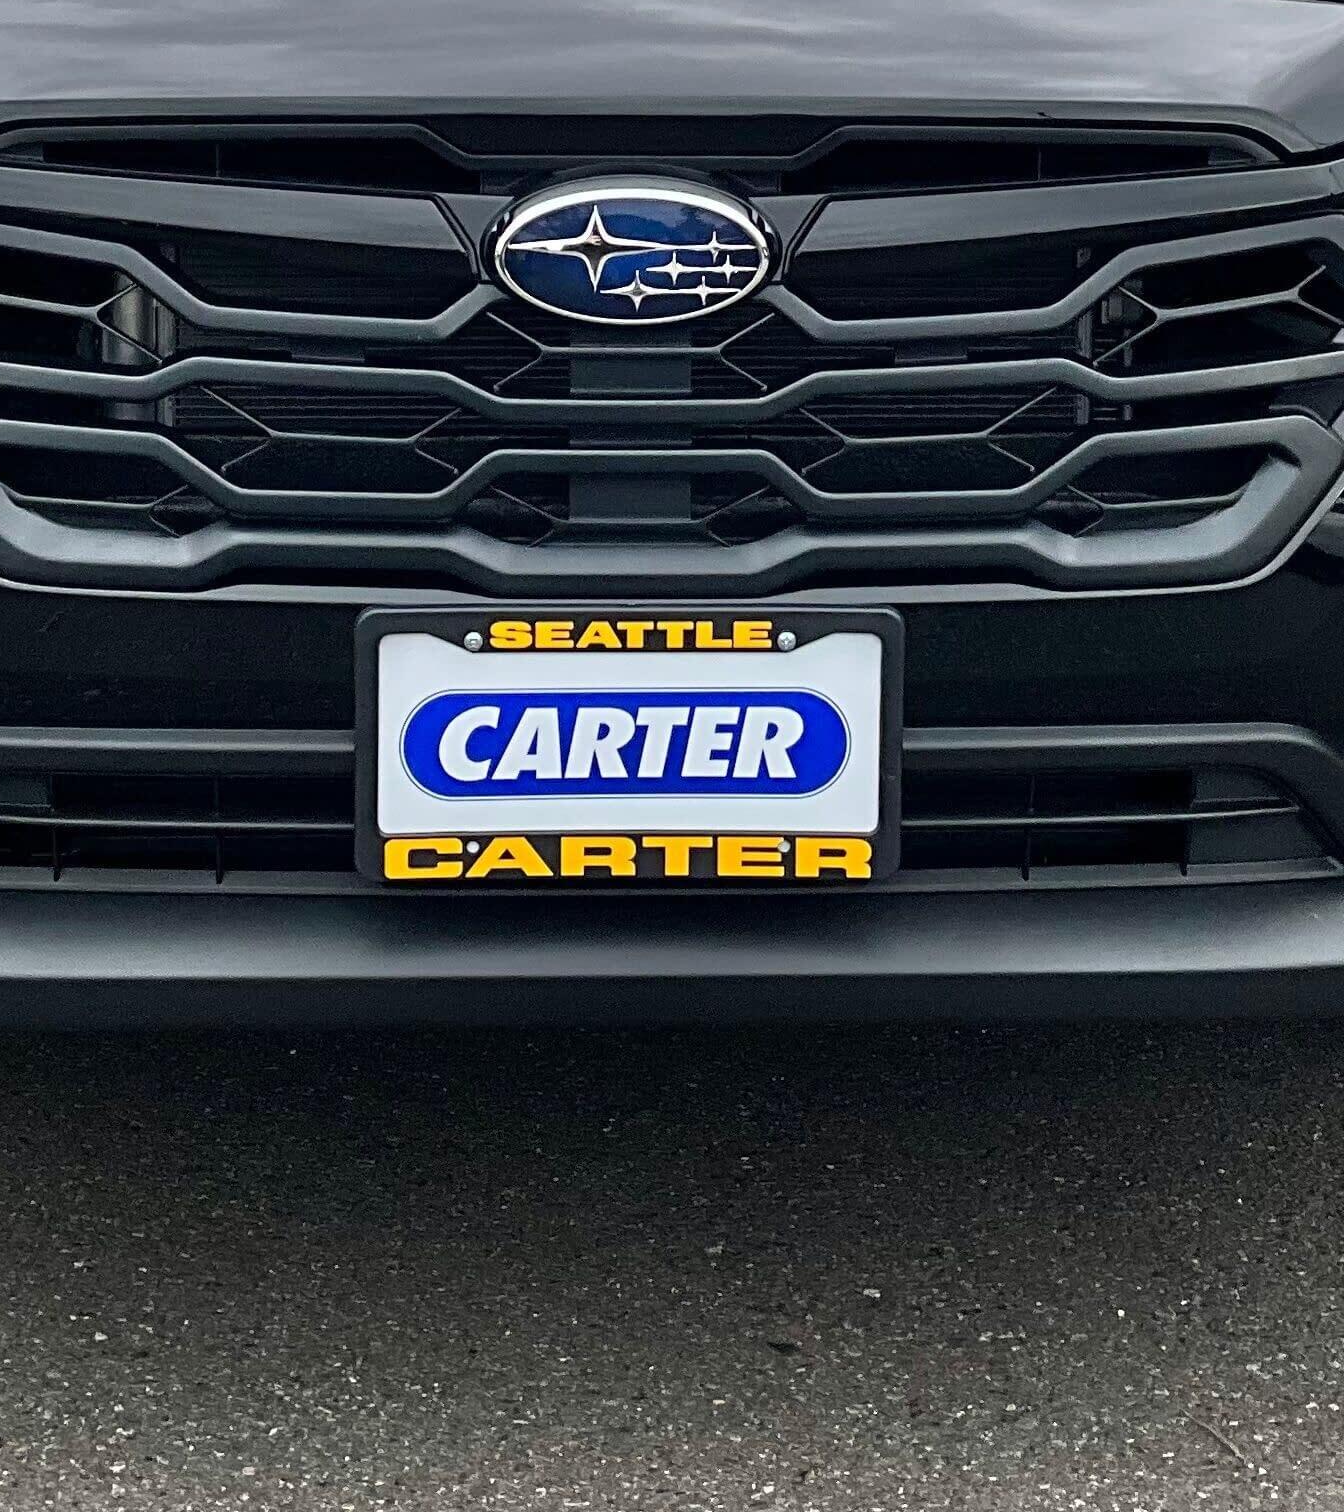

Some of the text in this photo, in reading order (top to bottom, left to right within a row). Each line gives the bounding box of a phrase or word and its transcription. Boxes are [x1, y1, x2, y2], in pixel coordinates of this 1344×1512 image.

[488, 620, 773, 649] SEATTLE
[437, 706, 805, 782] CARTER
[383, 836, 872, 879] CARTER
